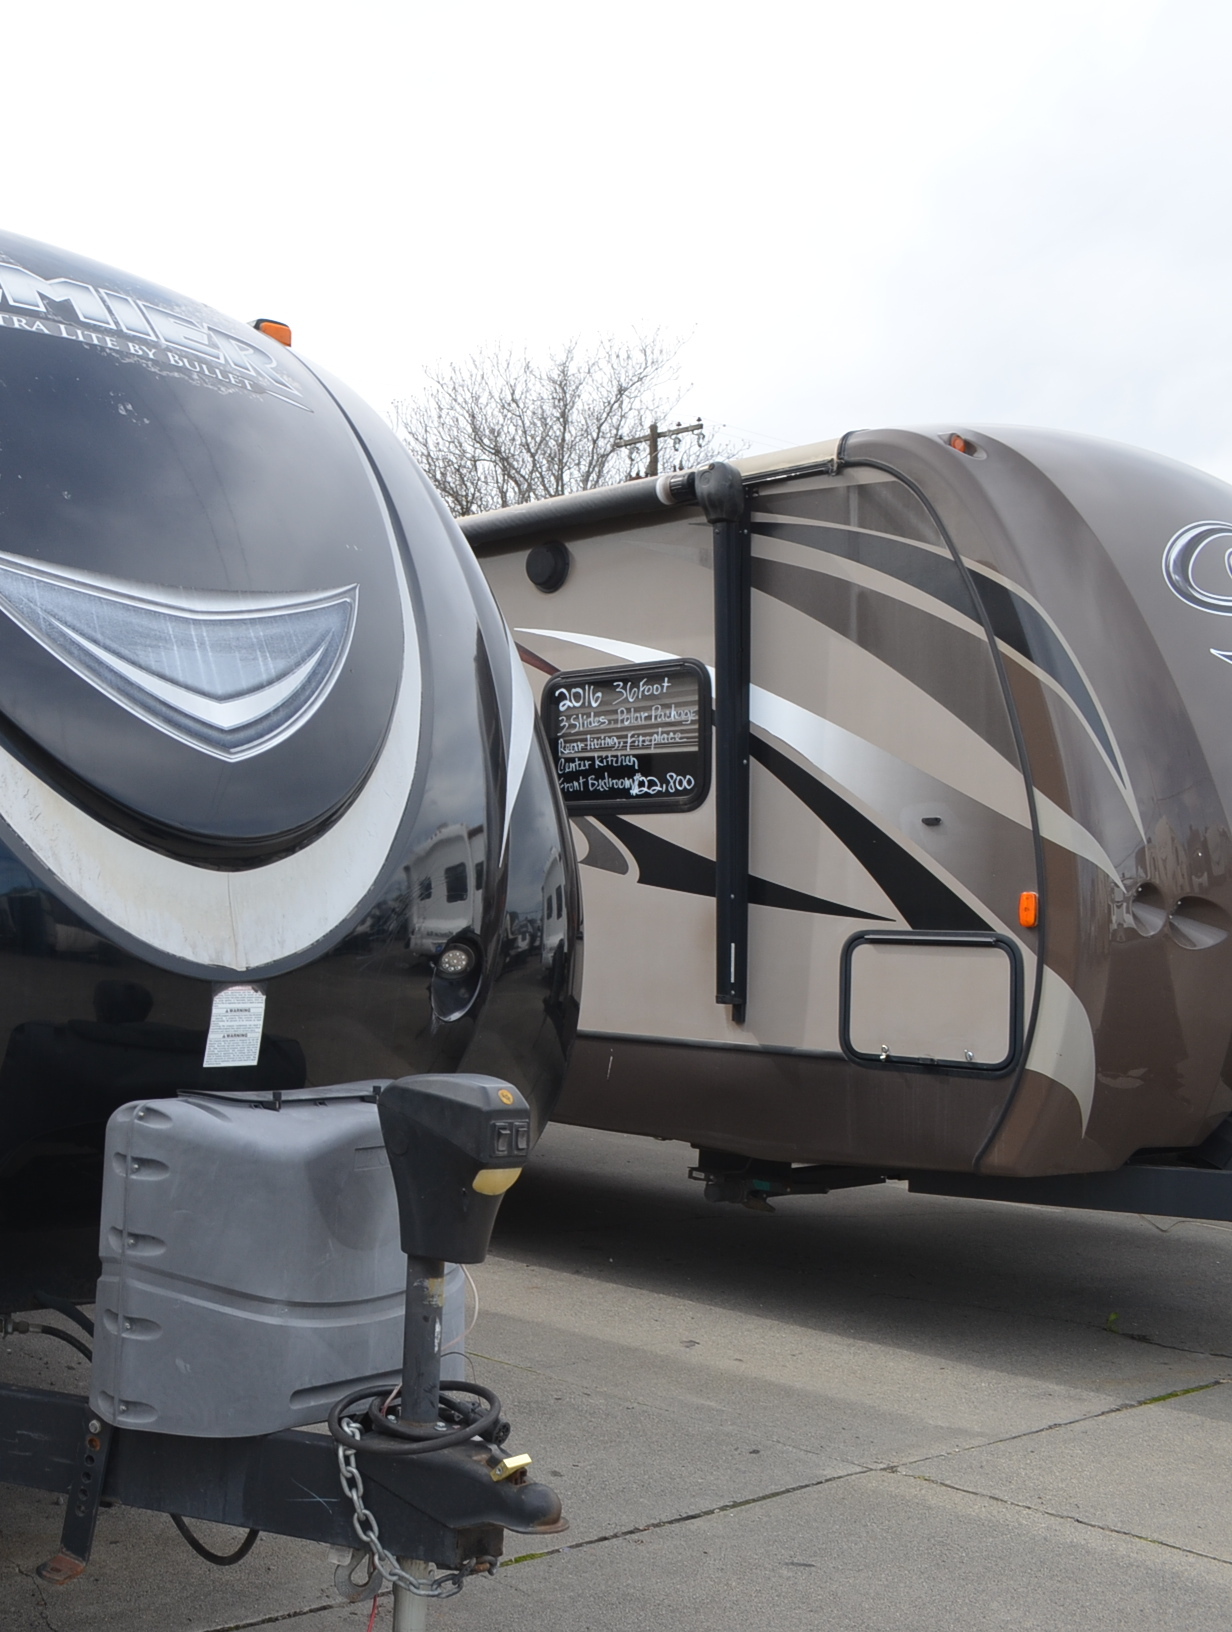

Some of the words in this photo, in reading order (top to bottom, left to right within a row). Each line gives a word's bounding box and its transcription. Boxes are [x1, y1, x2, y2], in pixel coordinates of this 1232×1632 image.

[58, 323, 120, 348] LITE
[127, 341, 158, 359] BY
[166, 351, 254, 391] BULLET
[555, 684, 602, 711] 2016
[617, 707, 648, 727] Polar
[558, 758, 592, 774] Center
[630, 772, 695, 796] $22,800
